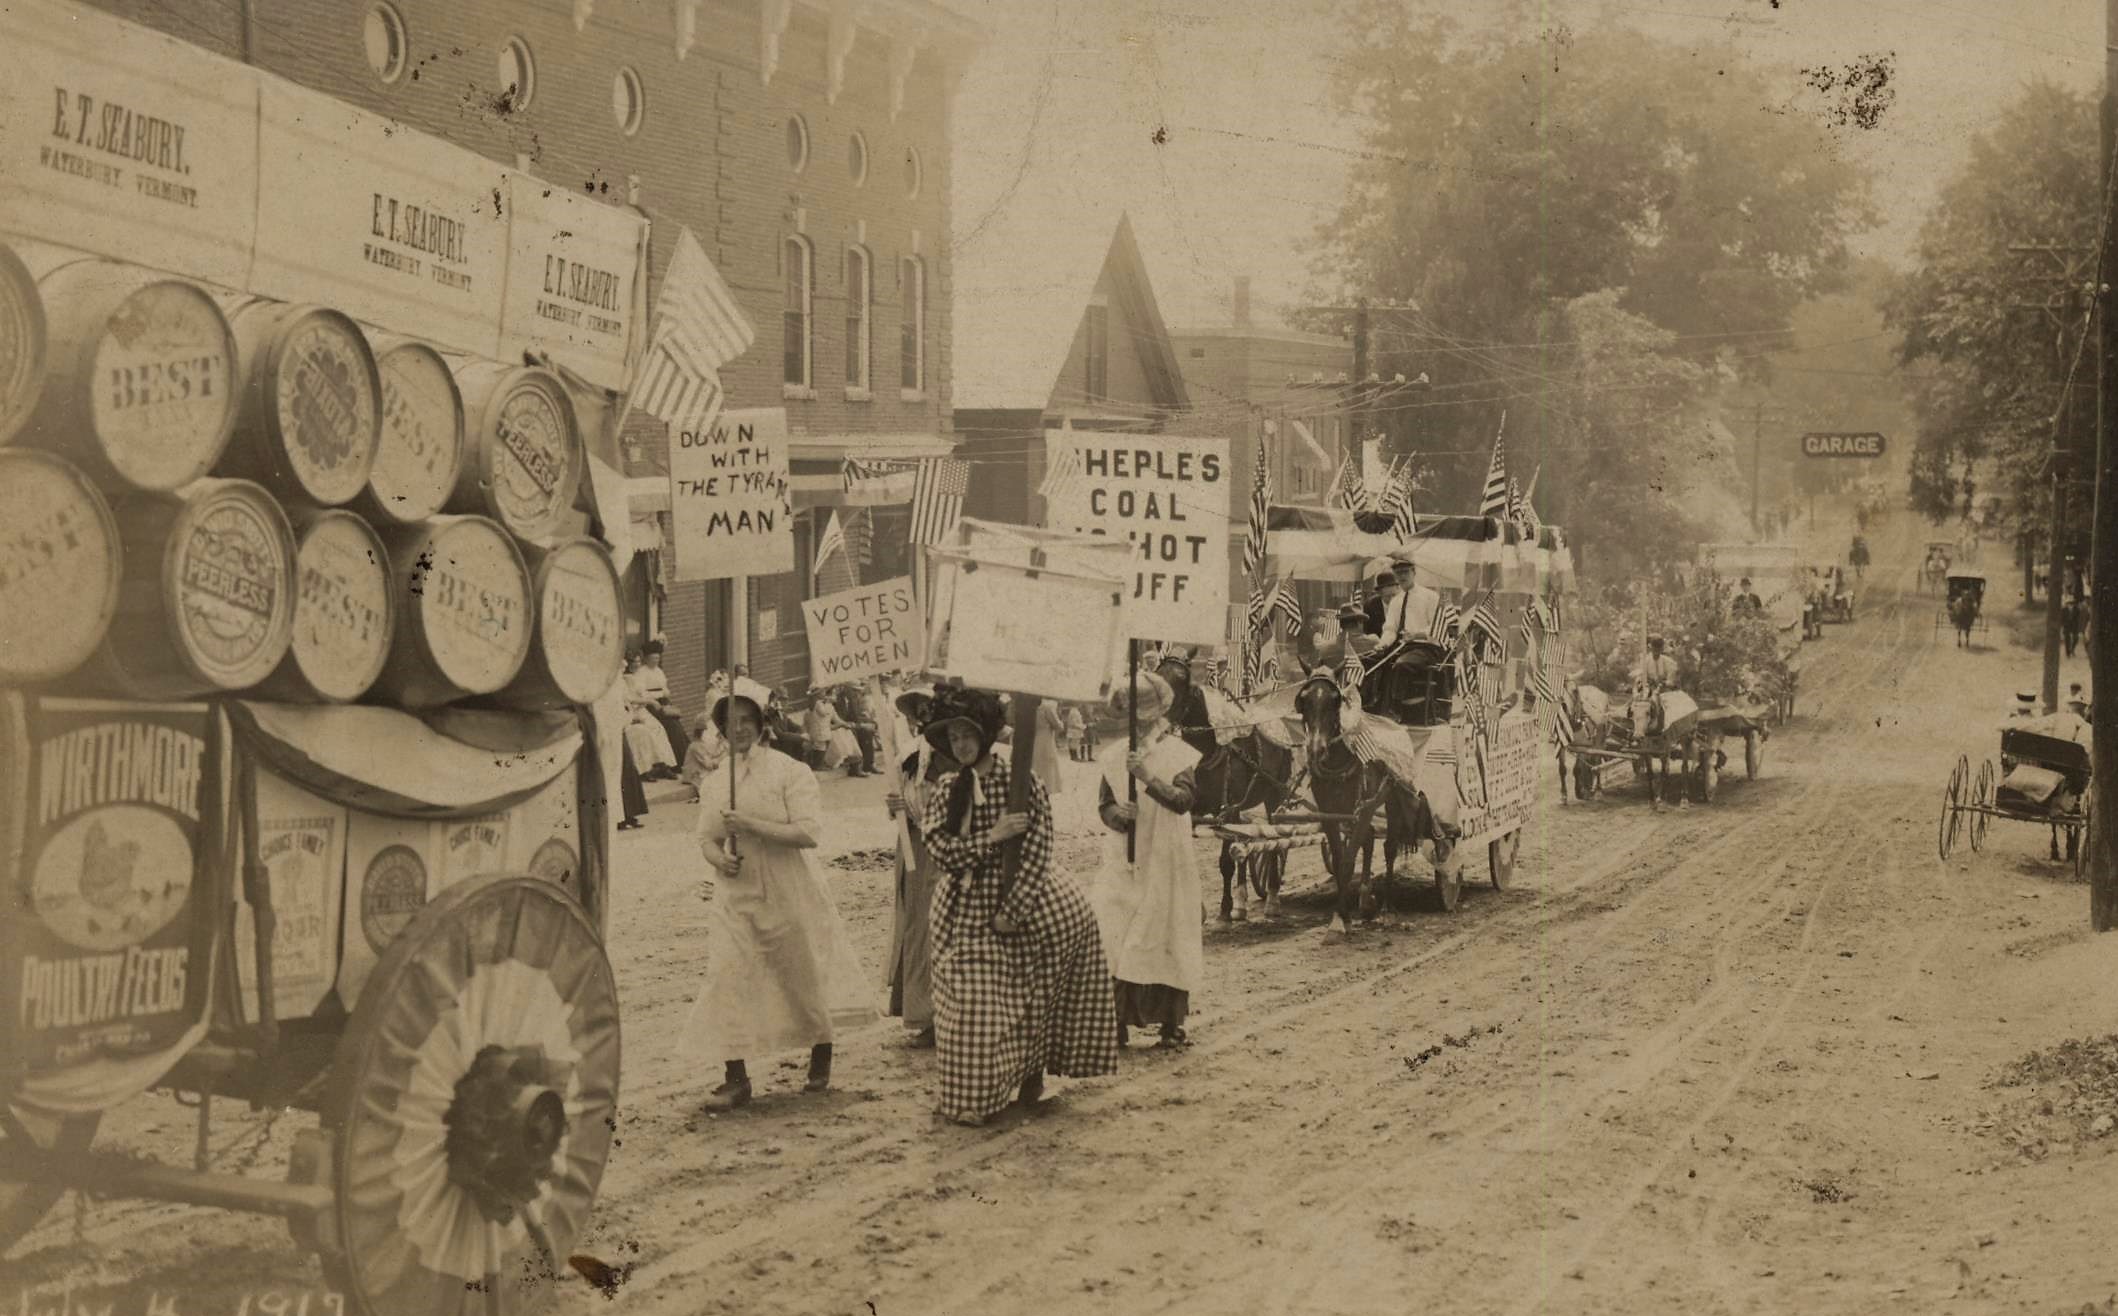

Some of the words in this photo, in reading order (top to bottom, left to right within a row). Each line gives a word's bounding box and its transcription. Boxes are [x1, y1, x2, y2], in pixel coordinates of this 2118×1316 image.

[96, 102, 190, 175] SEABURY.
[110, 352, 221, 411] BEST
[681, 423, 754, 449] DOWN
[1806, 437, 1880, 453] GARAGE
[711, 447, 770, 468] WITH
[1074, 448, 1221, 483] HEPLES
[677, 477, 719, 497] THE
[1091, 488, 1186, 522] COAL
[707, 509, 775, 537] MAN
[1129, 530, 1207, 564] HOT
[186, 561, 270, 613] PEERLESS
[303, 567, 379, 642] BEST
[437, 571, 517, 637] BEST
[551, 589, 613, 647] BEST
[812, 588, 910, 626] VOTES
[838, 617, 897, 645] FOR
[821, 640, 910, 674] WOMEN
[40, 722, 205, 828] WIRTHMORE
[21, 953, 125, 1031] POULTRY
[120, 945, 189, 1017] FEEDS
